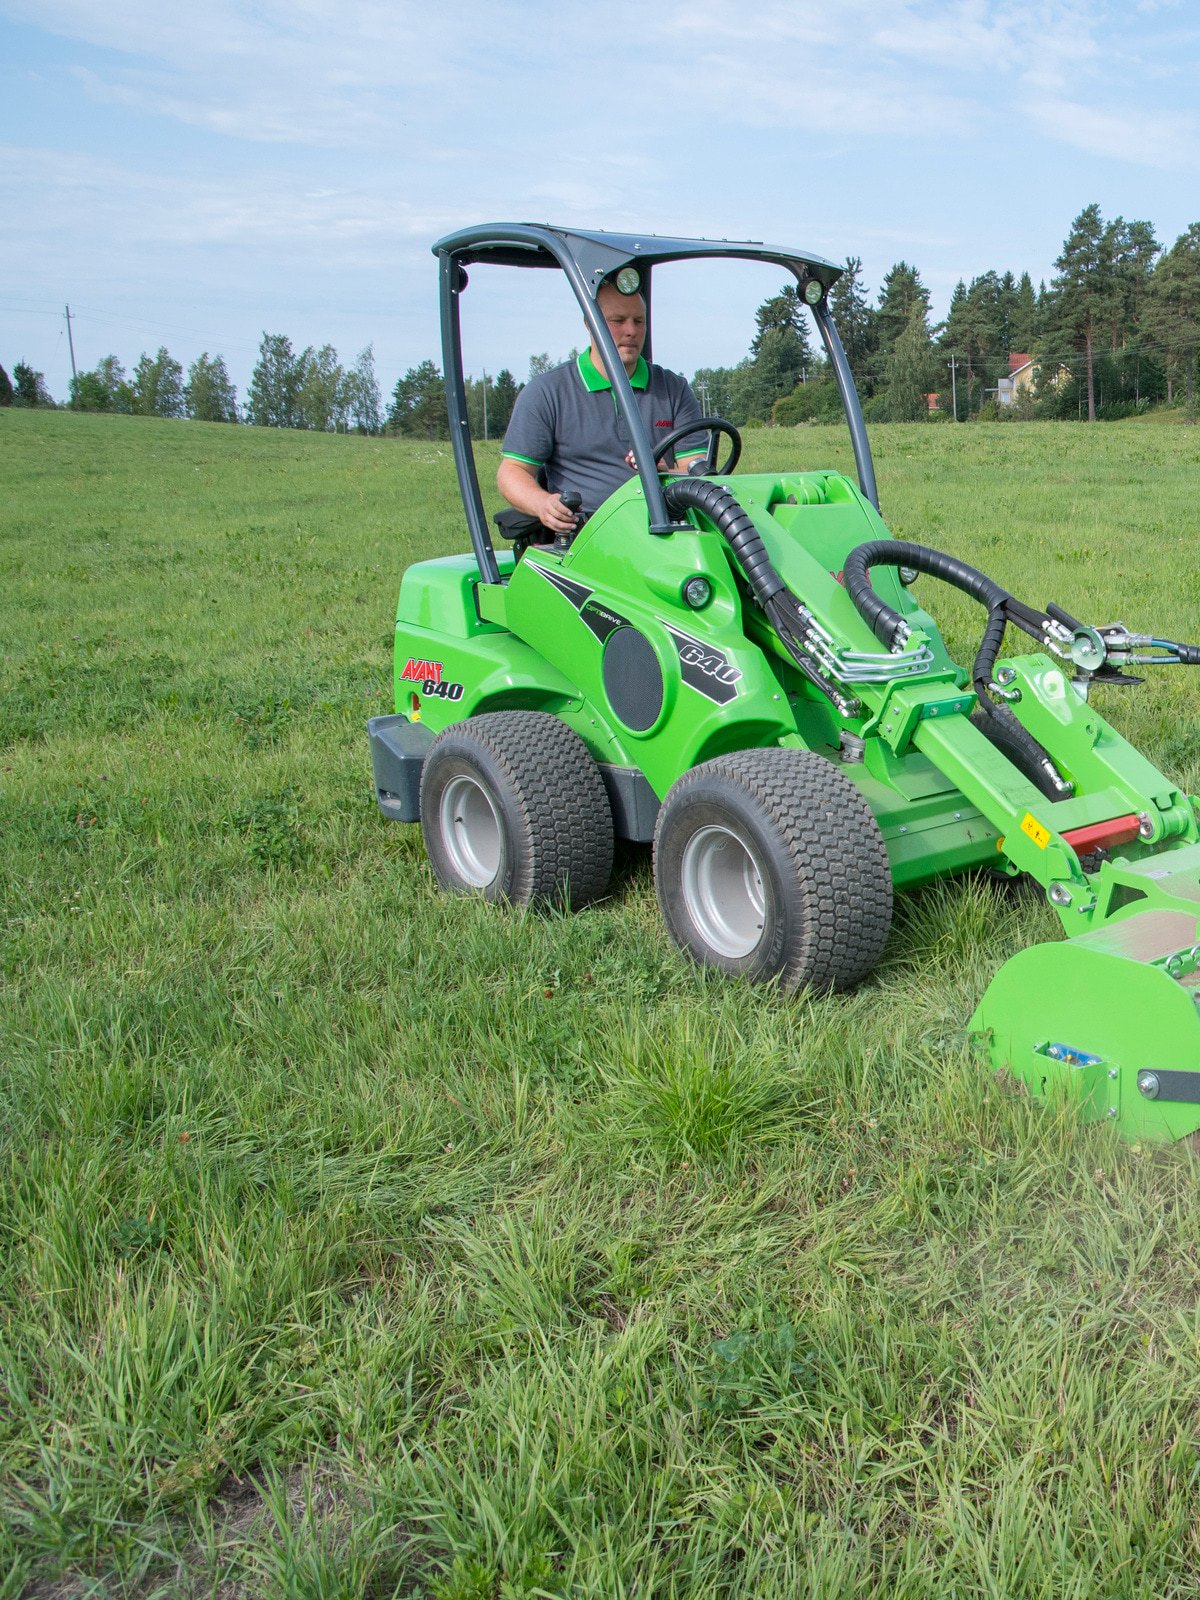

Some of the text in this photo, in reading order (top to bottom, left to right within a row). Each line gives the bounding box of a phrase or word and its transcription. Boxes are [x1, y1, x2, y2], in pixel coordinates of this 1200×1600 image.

[399, 657, 444, 684] AVANT
[679, 645, 743, 684] 640
[422, 680, 464, 701] 640
